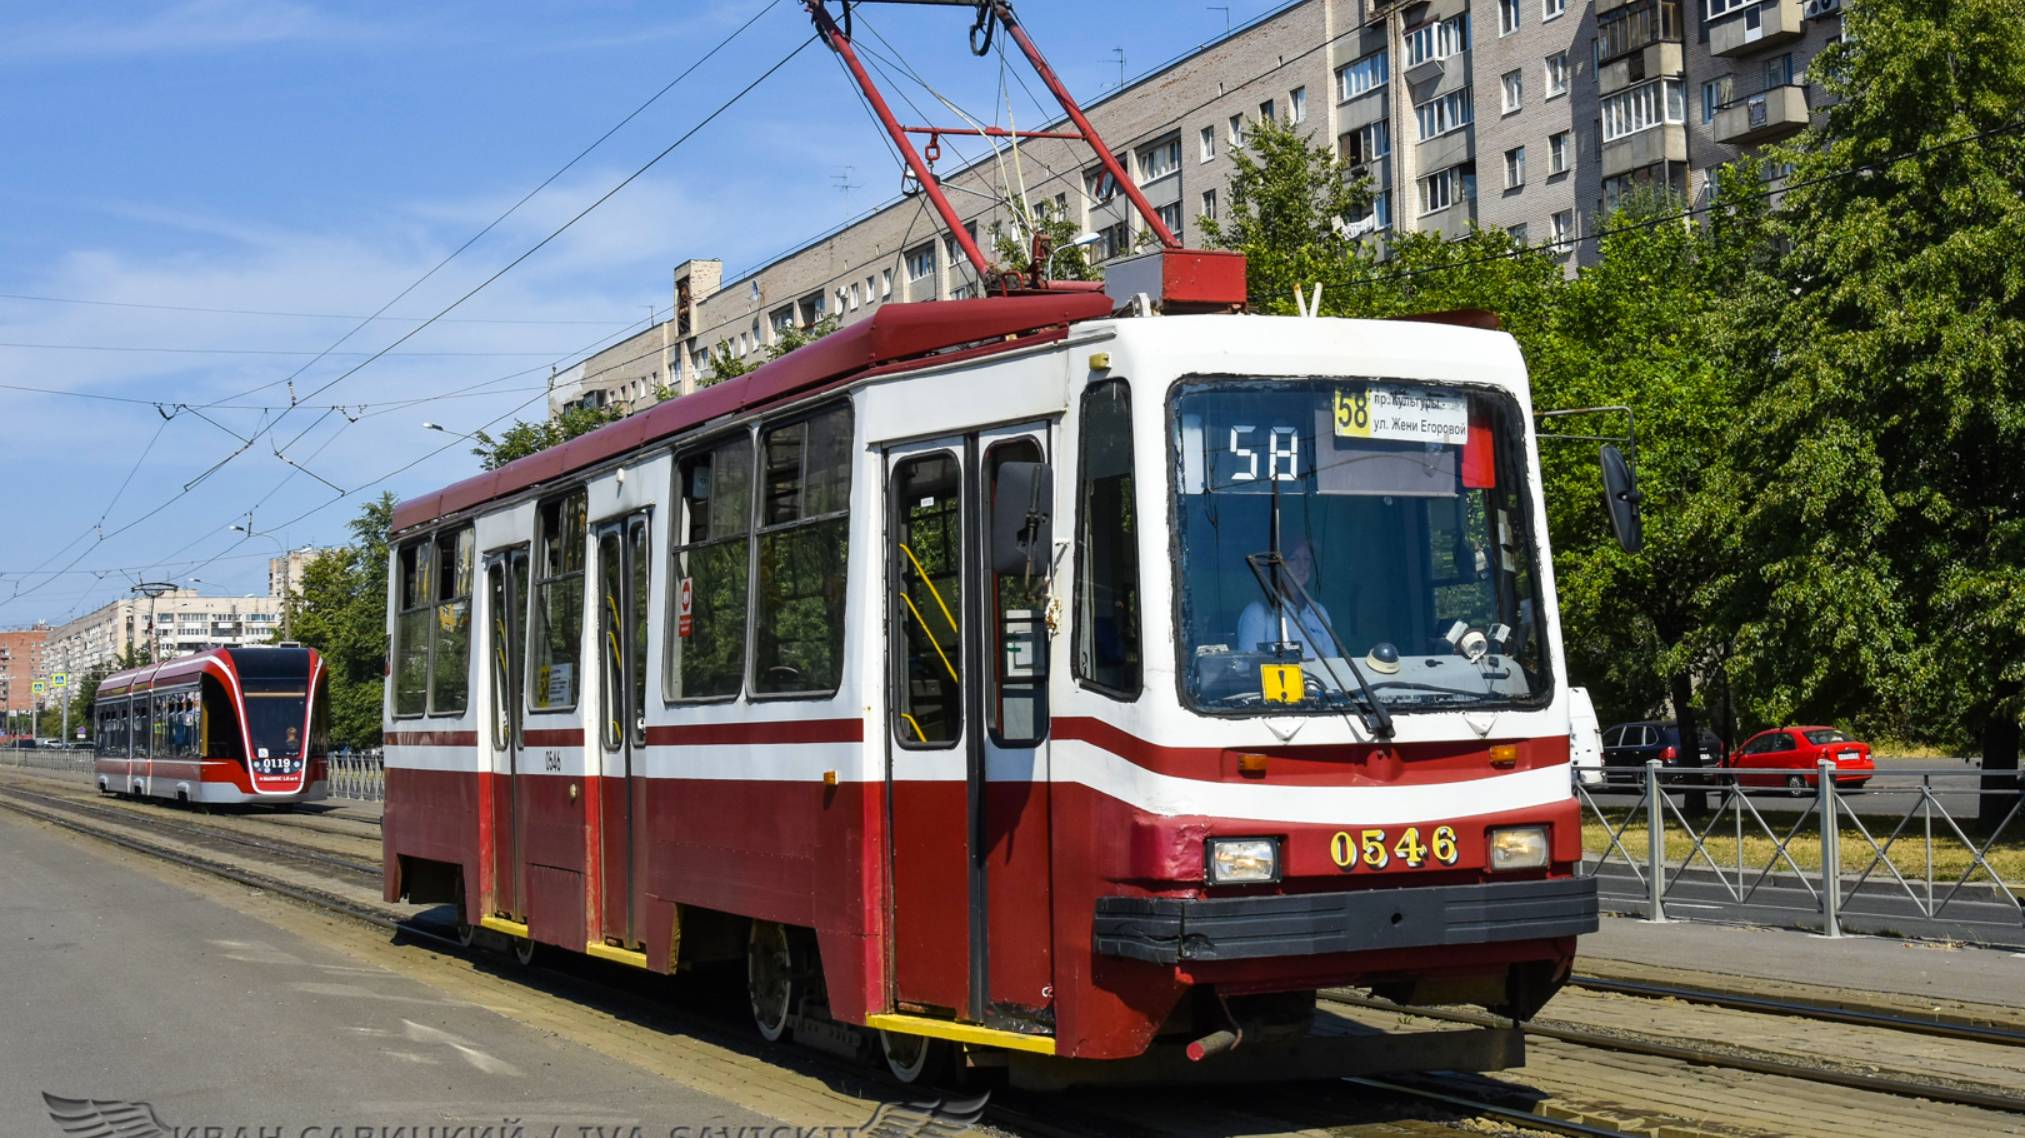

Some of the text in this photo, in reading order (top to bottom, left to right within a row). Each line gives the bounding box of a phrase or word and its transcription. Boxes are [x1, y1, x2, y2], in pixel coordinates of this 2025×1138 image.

[1337, 388, 1368, 428] 58
[1373, 417, 1466, 436] ул. Жени Егоровой
[1230, 425, 1298, 481] 58
[263, 758, 291, 768] 0119
[545, 750, 561, 772] 0546
[1330, 825, 1458, 868] 0546
